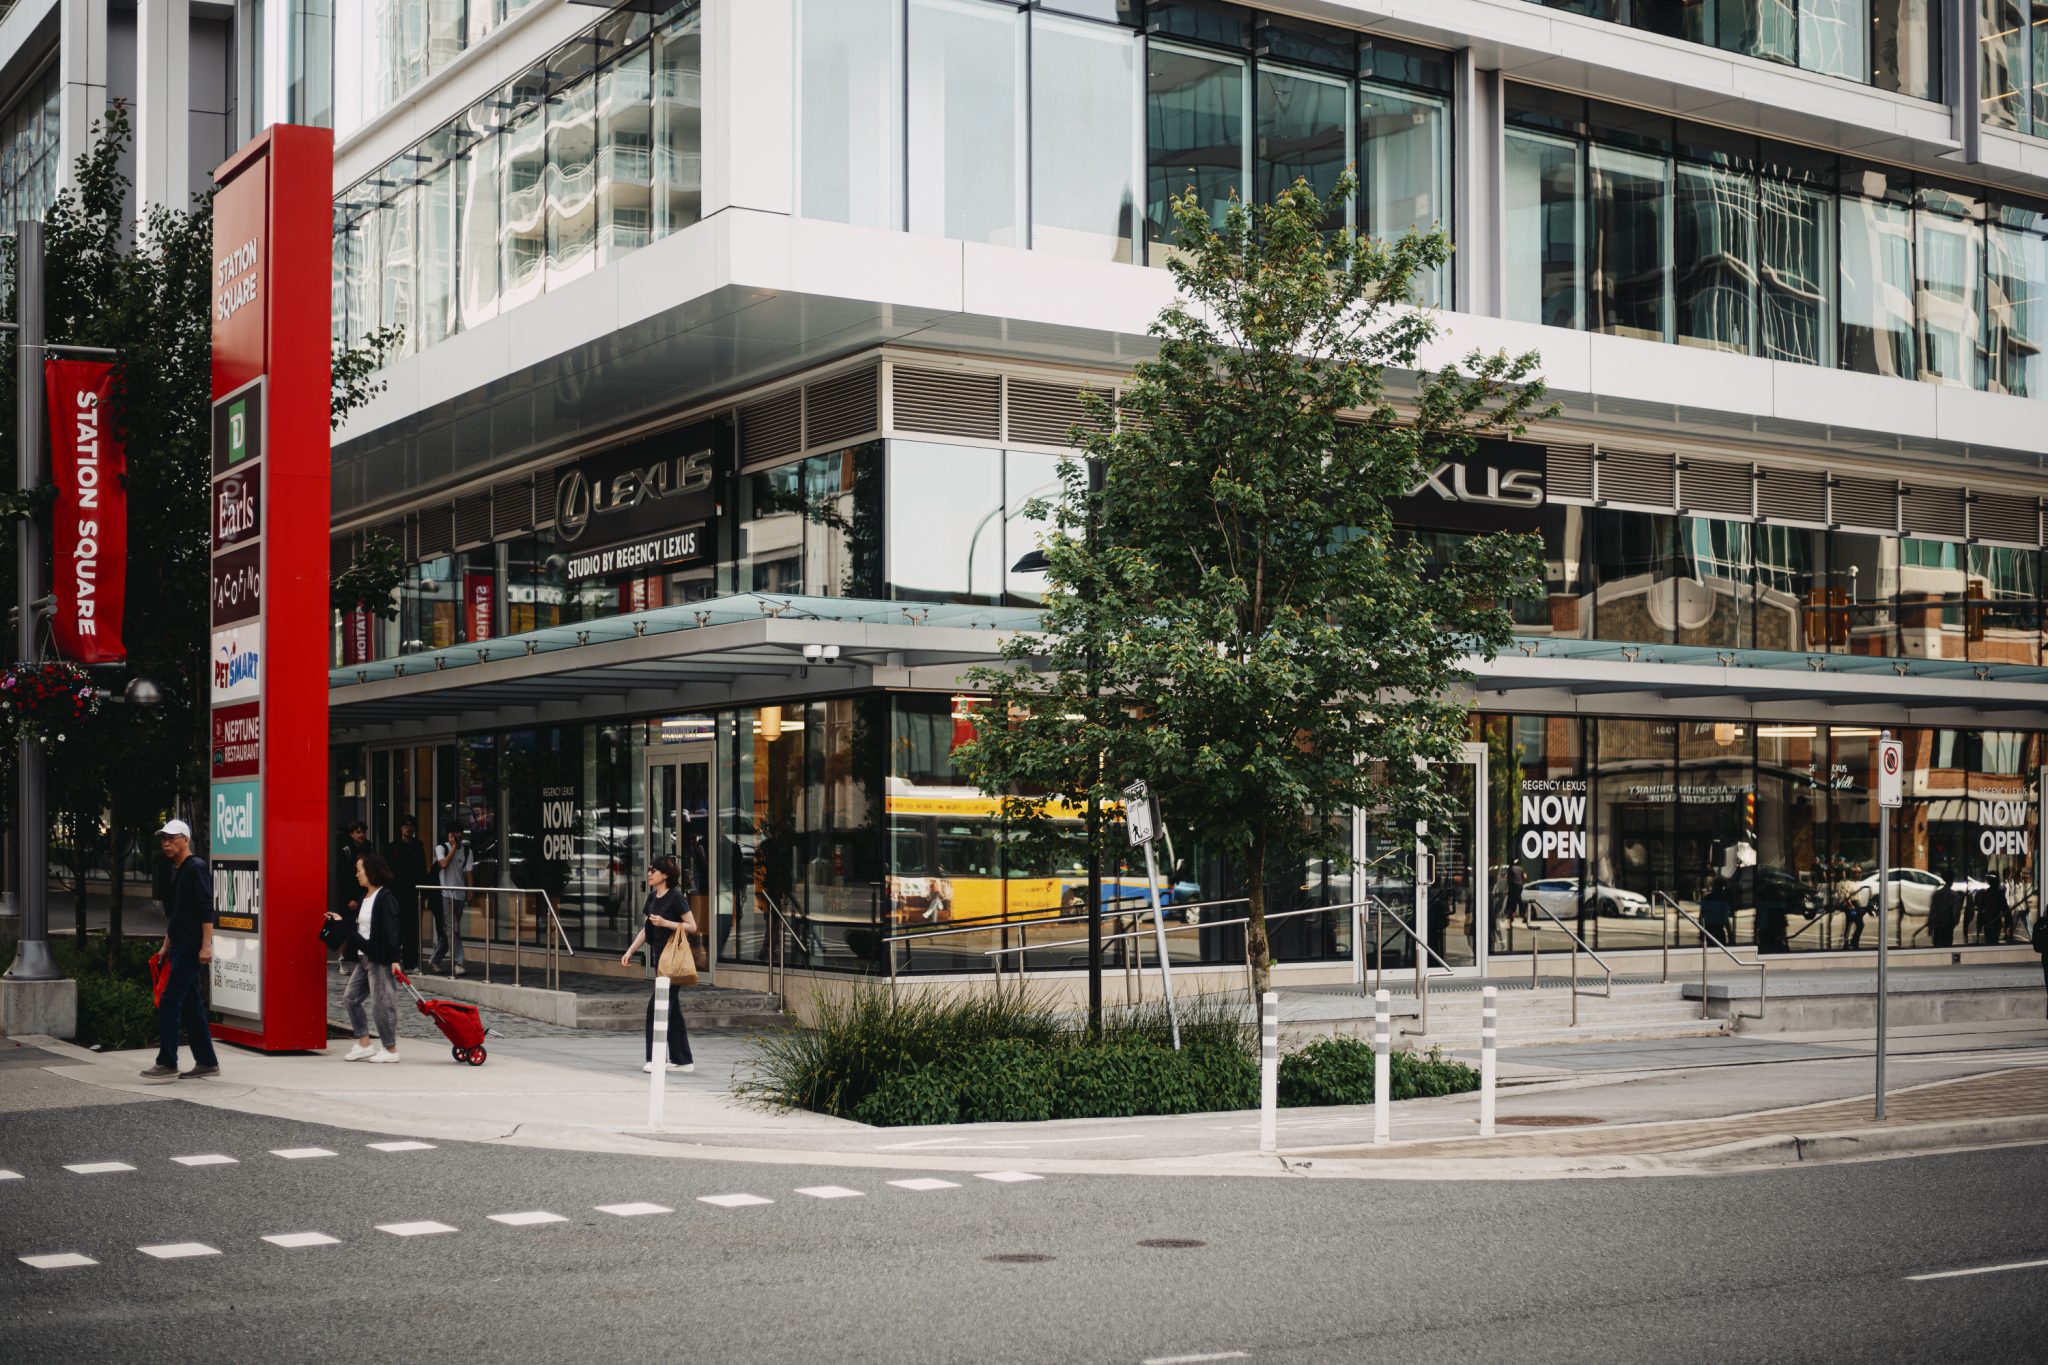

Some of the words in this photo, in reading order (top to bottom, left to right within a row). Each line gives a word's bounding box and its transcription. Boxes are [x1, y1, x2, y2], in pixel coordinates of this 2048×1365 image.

[218, 237, 257, 288] STATION
[218, 272, 257, 321] SQUARE
[76, 390, 98, 508] STATION
[231, 412, 244, 450] TD
[593, 448, 713, 513] LEXUS
[1403, 461, 1544, 508] XUS
[219, 481, 254, 539] Earls
[568, 554, 601, 579] STUDIO
[602, 551, 615, 572] BY
[616, 540, 661, 569] REGENCY
[663, 532, 695, 559] LEXUS
[73, 519, 98, 636] SQUARE
[213, 565, 260, 608] TACOFINO
[225, 716, 259, 743] NEPTUNE
[225, 743, 259, 763] RESTAURANT
[543, 787, 560, 797] REGENCY
[562, 786, 574, 796] LEXUS
[1522, 780, 1560, 791] REGENCY
[1562, 780, 1587, 791] LEXUS
[217, 792, 253, 845] Rexall
[543, 801, 574, 829] NOW
[1522, 795, 1587, 826] NOW
[1979, 800, 2028, 826] NOW
[543, 834, 575, 860] OPEN
[1521, 830, 1586, 859] OPEN
[1980, 830, 2028, 856] OPEN
